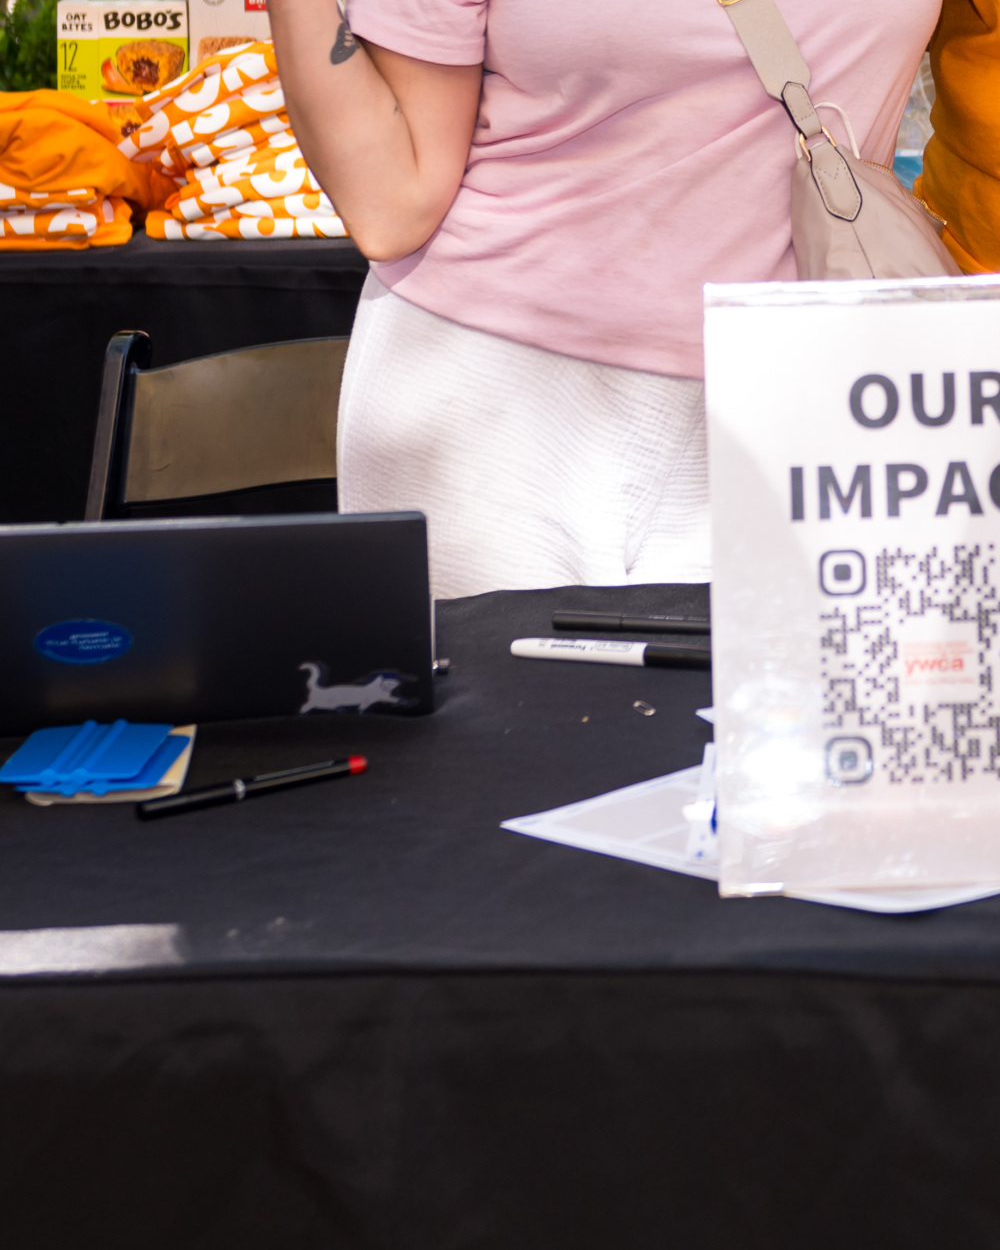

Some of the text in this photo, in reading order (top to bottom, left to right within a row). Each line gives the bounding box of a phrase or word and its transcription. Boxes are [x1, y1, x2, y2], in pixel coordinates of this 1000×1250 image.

[66, 13, 87, 21] OAT
[104, 9, 183, 30] BOBO'S
[62, 23, 93, 31] BITES
[60, 41, 78, 72] 12
[905, 658, 964, 676] ywca
